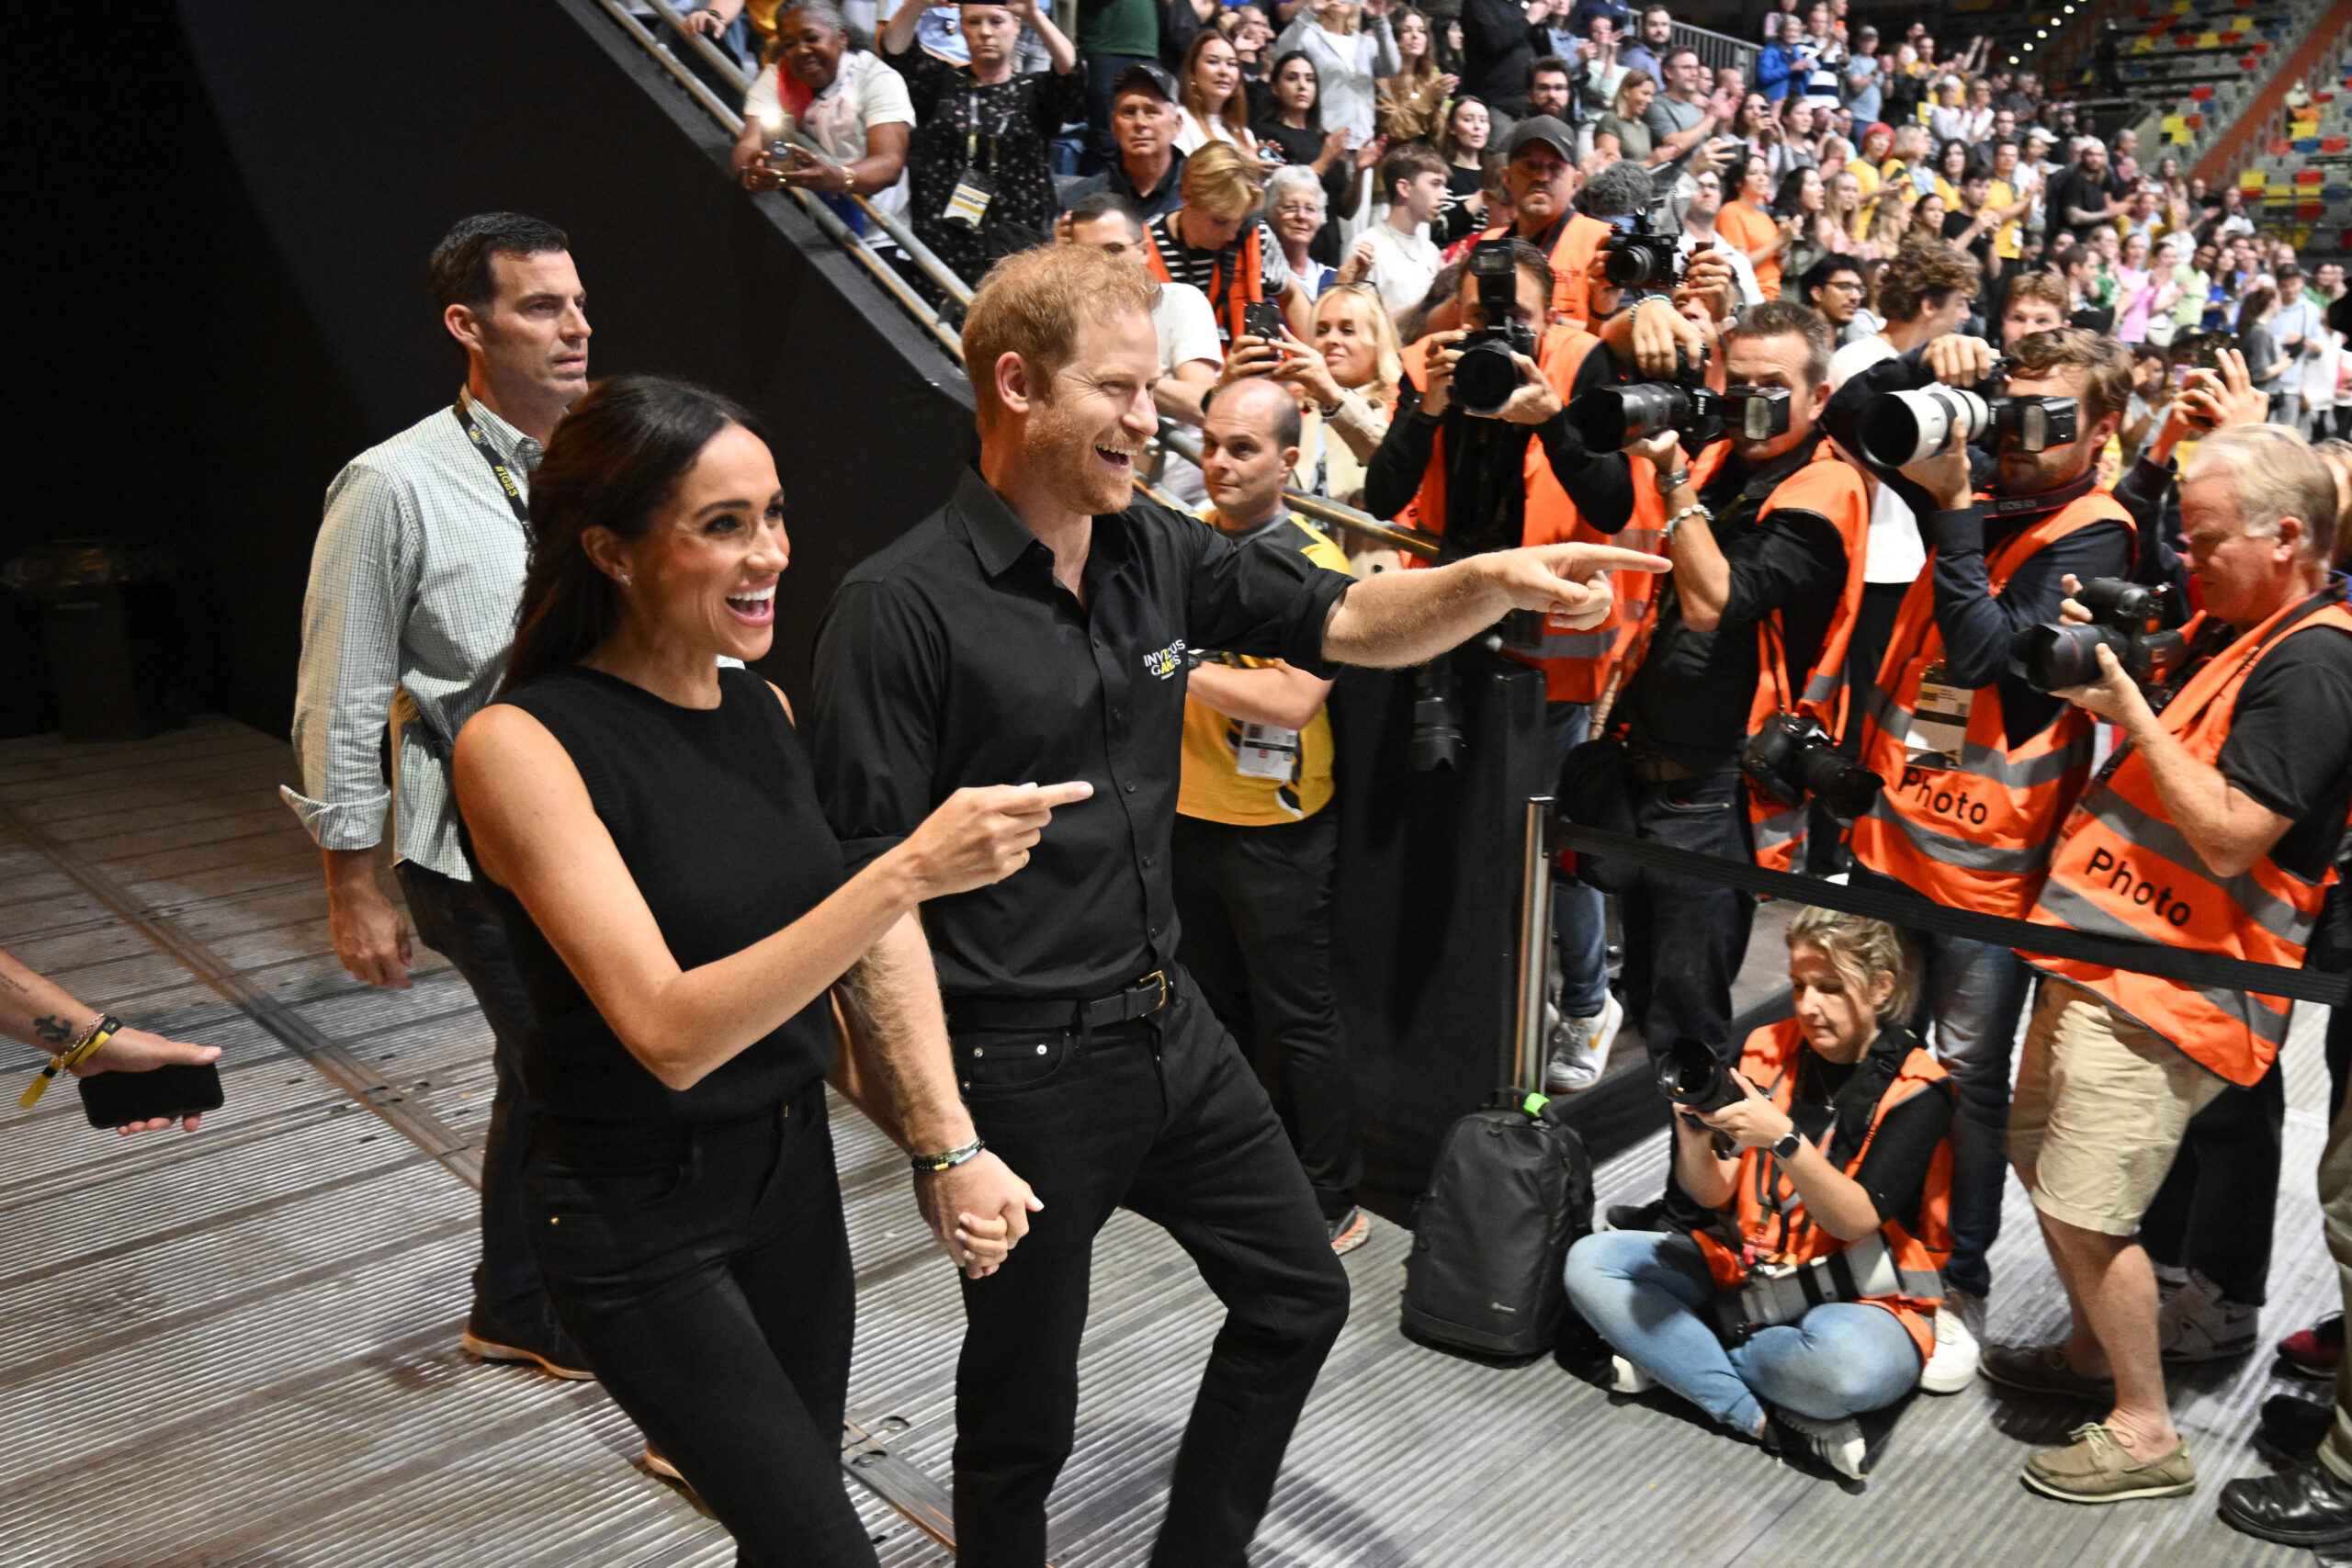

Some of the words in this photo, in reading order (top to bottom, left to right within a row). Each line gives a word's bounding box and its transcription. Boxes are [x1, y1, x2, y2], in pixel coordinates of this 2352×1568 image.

[495, 466, 518, 497] #IG23
[1897, 766, 1987, 825] Photo
[2085, 846, 2191, 927] Photo
